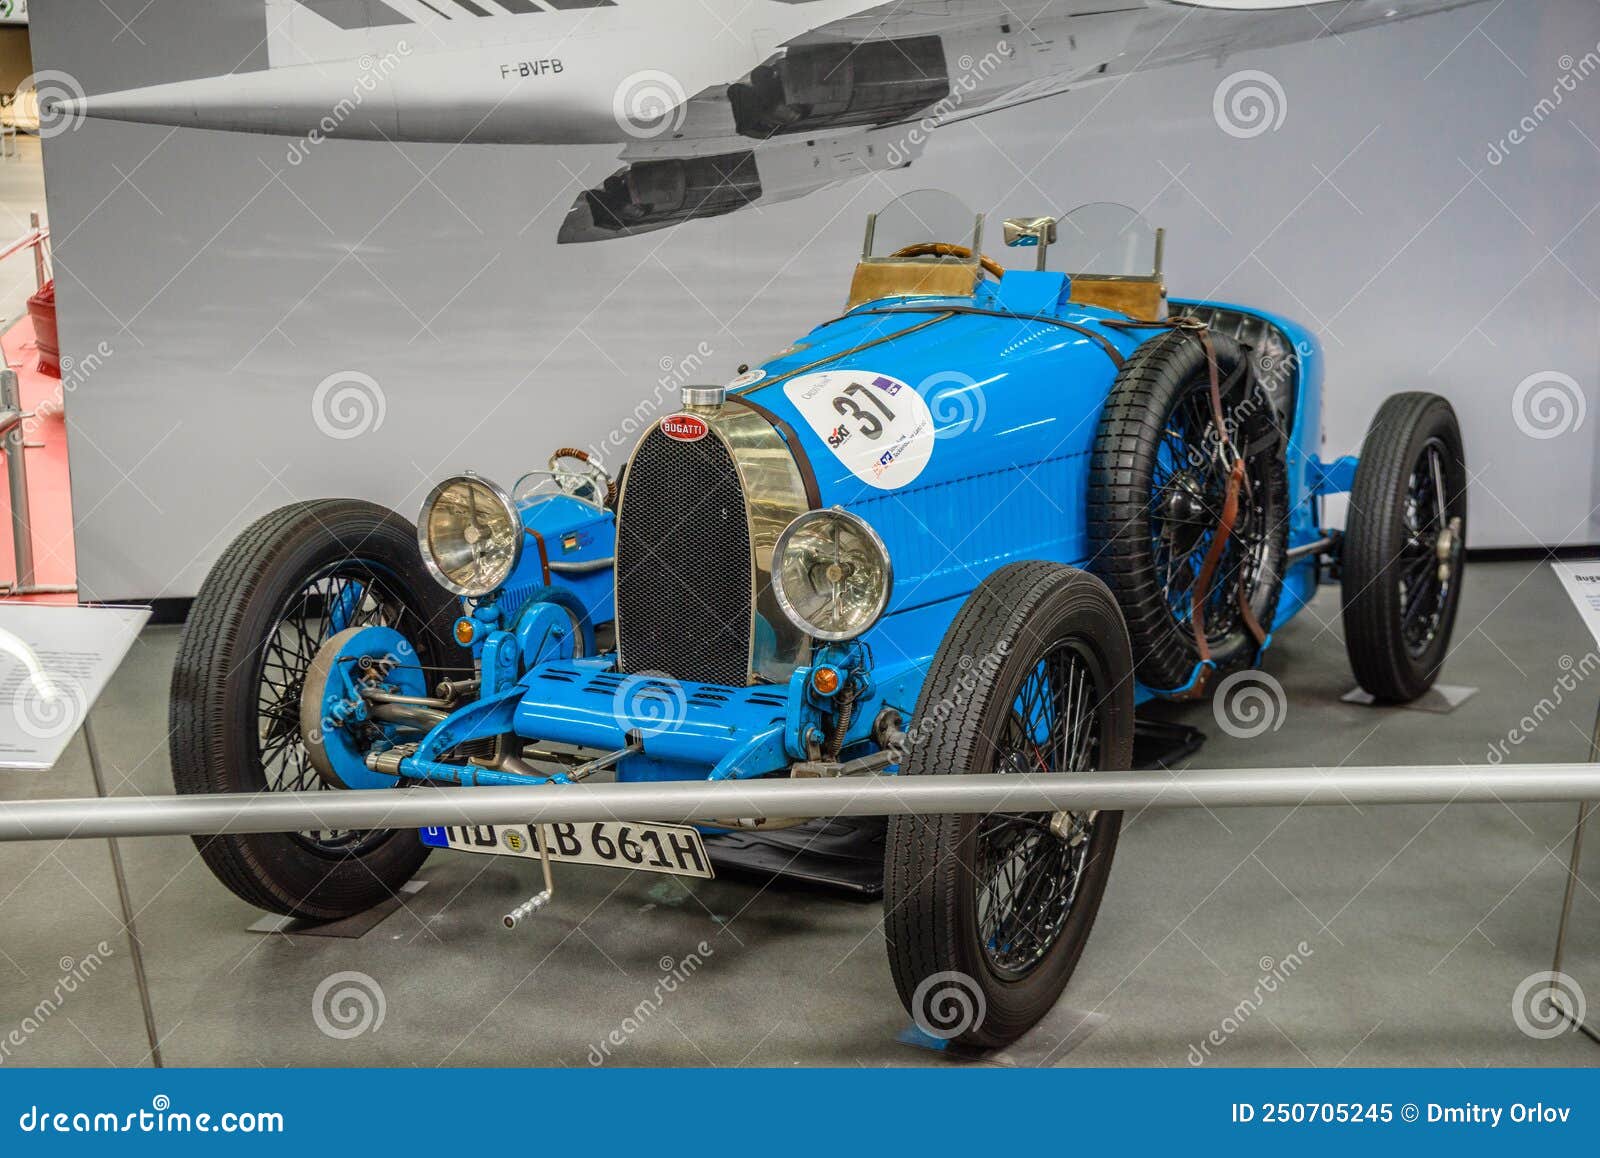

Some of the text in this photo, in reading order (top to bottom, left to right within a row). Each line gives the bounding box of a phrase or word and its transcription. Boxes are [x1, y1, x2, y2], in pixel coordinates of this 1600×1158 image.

[500, 58, 563, 79] F-BVFB
[664, 422, 702, 435] BUGATTI
[833, 382, 896, 440] 37
[592, 823, 705, 872] 661H
